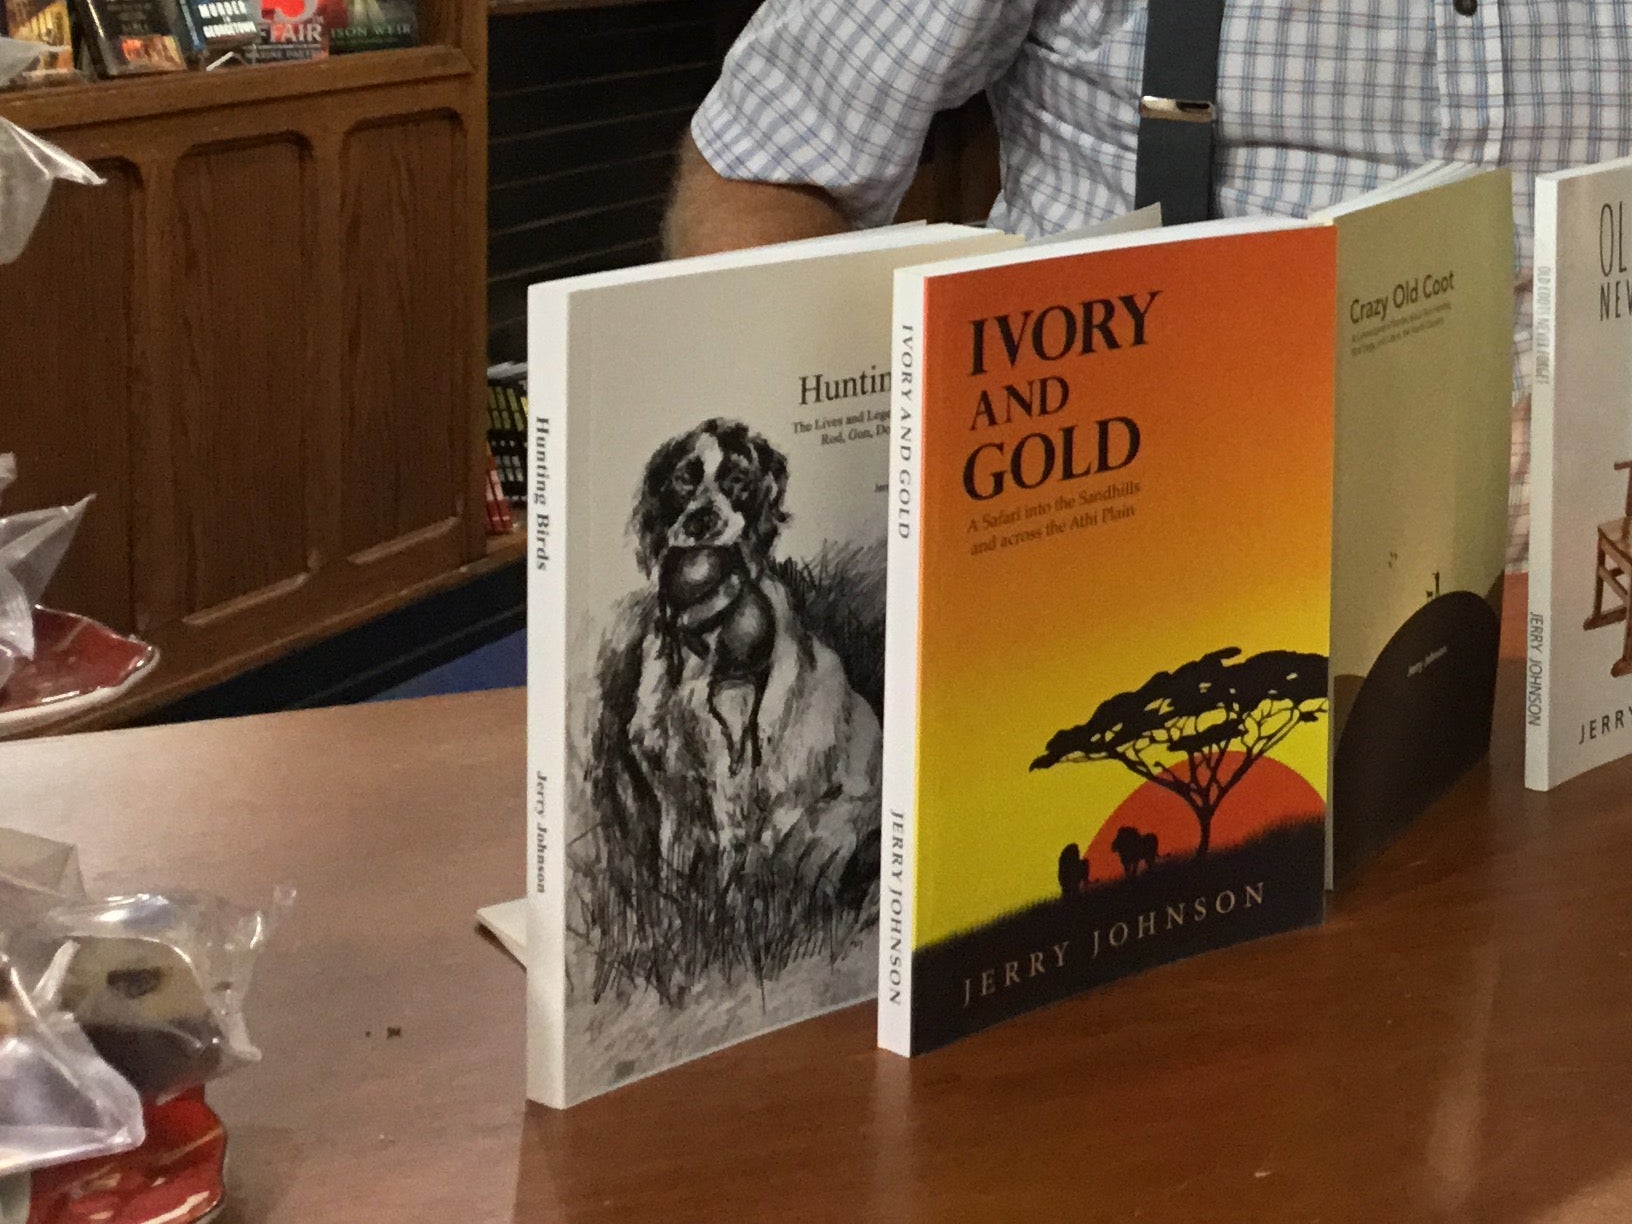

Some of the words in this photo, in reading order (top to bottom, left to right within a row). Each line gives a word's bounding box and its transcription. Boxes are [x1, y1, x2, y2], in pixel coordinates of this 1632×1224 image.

[1349, 295, 1390, 325] Crazy
[1391, 277, 1420, 310] Old
[1422, 269, 1456, 300] Coot
[900, 324, 914, 402] IVORY
[967, 289, 1164, 377] IVORY
[798, 364, 892, 407] Huntin
[969, 375, 1071, 432] AND
[532, 416, 550, 506] Hunting
[875, 423, 891, 436] Do
[899, 405, 913, 462] AND
[961, 415, 1142, 503] GOLD
[897, 468, 912, 540] GOLD
[966, 518, 979, 534] A
[982, 505, 1022, 531] Safari
[1023, 501, 1051, 520] into
[1053, 494, 1076, 512] the
[1077, 479, 1142, 506] Sandhills
[970, 533, 998, 557] and
[1000, 528, 1043, 550] across
[1045, 517, 1068, 538] the
[1069, 510, 1099, 532] Athi
[1101, 503, 1136, 524] Plain
[535, 512, 550, 571] Birds
[1529, 611, 1544, 655] JERRY
[1528, 658, 1544, 727] JOHNSON
[534, 770, 548, 818] Jerry
[536, 822, 548, 894] Johnson
[889, 809, 905, 882] JERRY
[888, 883, 904, 1006] JOHNSON
[961, 940, 1073, 1007] JERRY
[1092, 881, 1267, 959] JOHNSON
